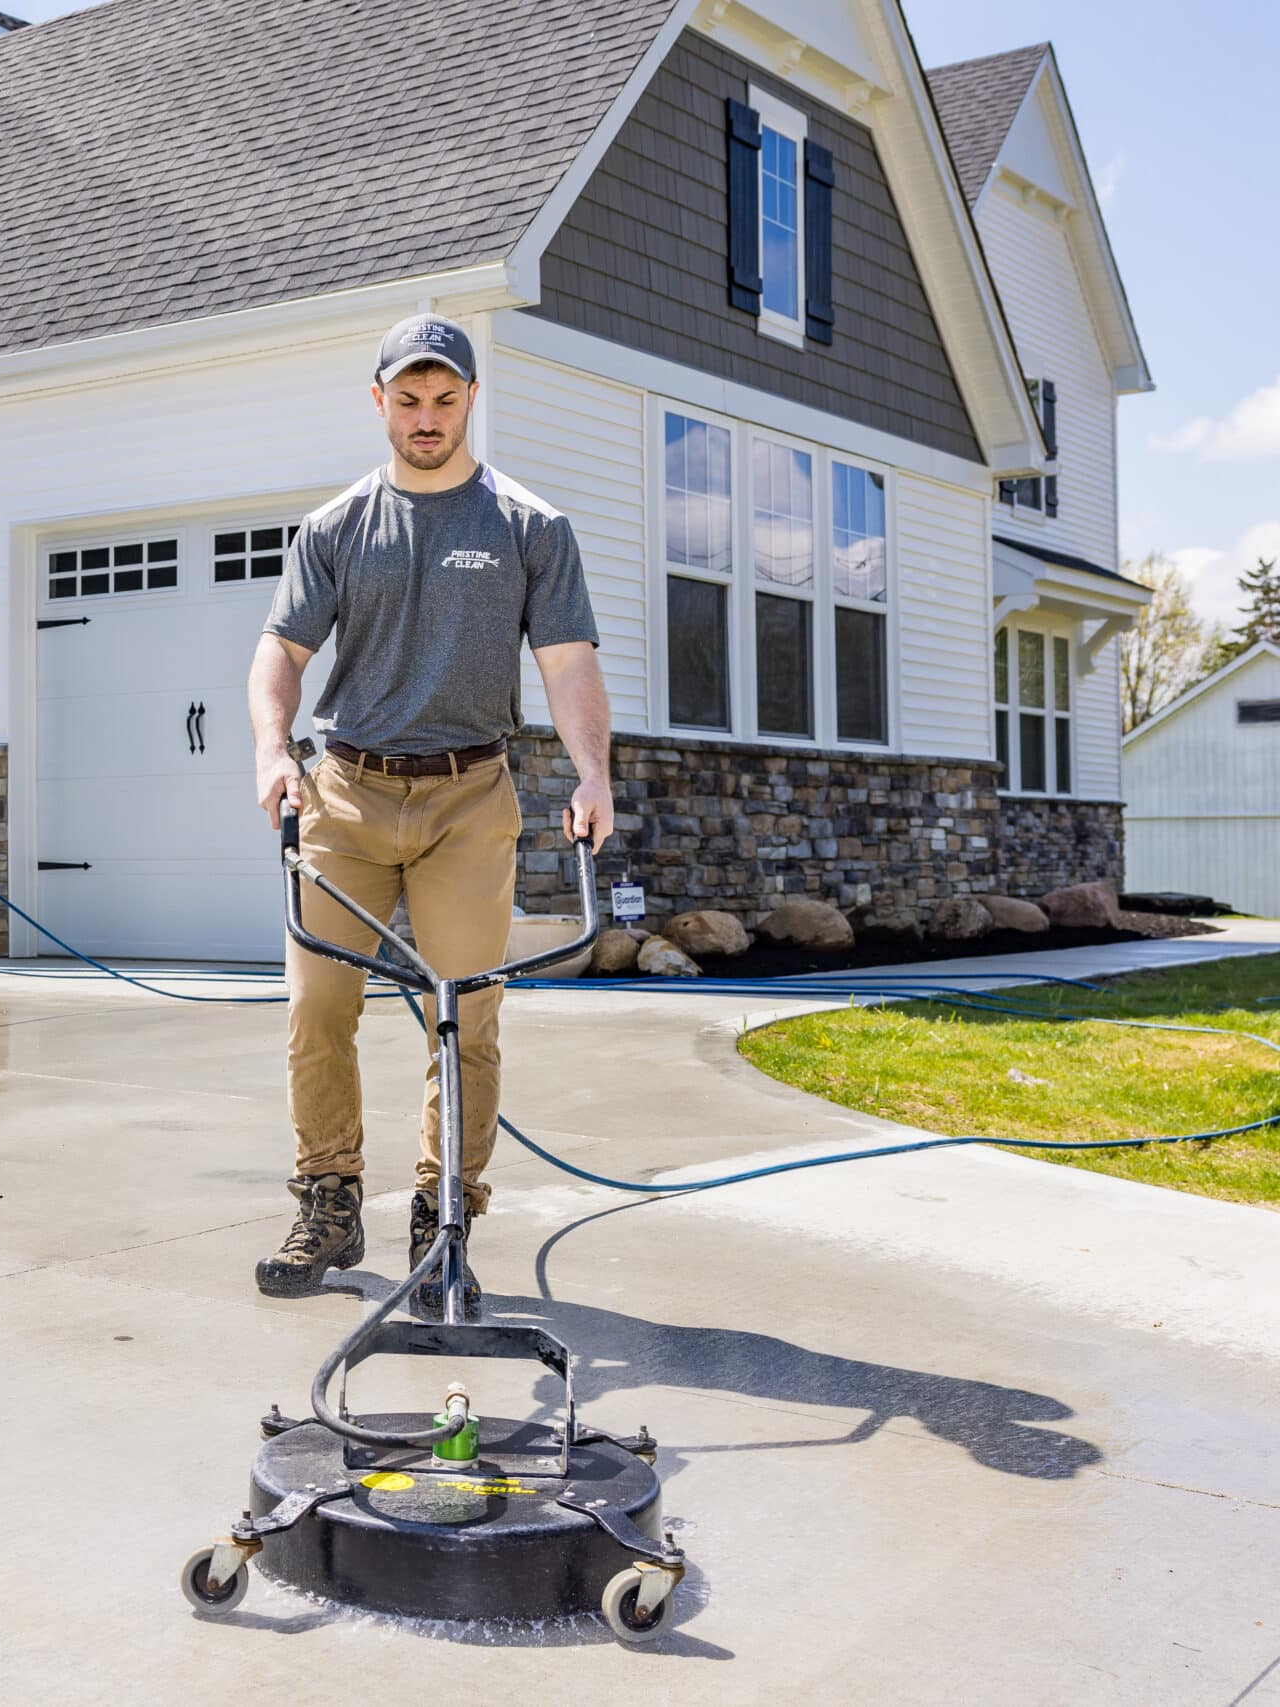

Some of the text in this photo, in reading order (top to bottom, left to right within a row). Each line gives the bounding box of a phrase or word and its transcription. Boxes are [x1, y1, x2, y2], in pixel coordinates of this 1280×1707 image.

[412, 334, 441, 342] CLEAN
[451, 550, 491, 560] PRISTINE
[455, 560, 484, 569] CLEAN
